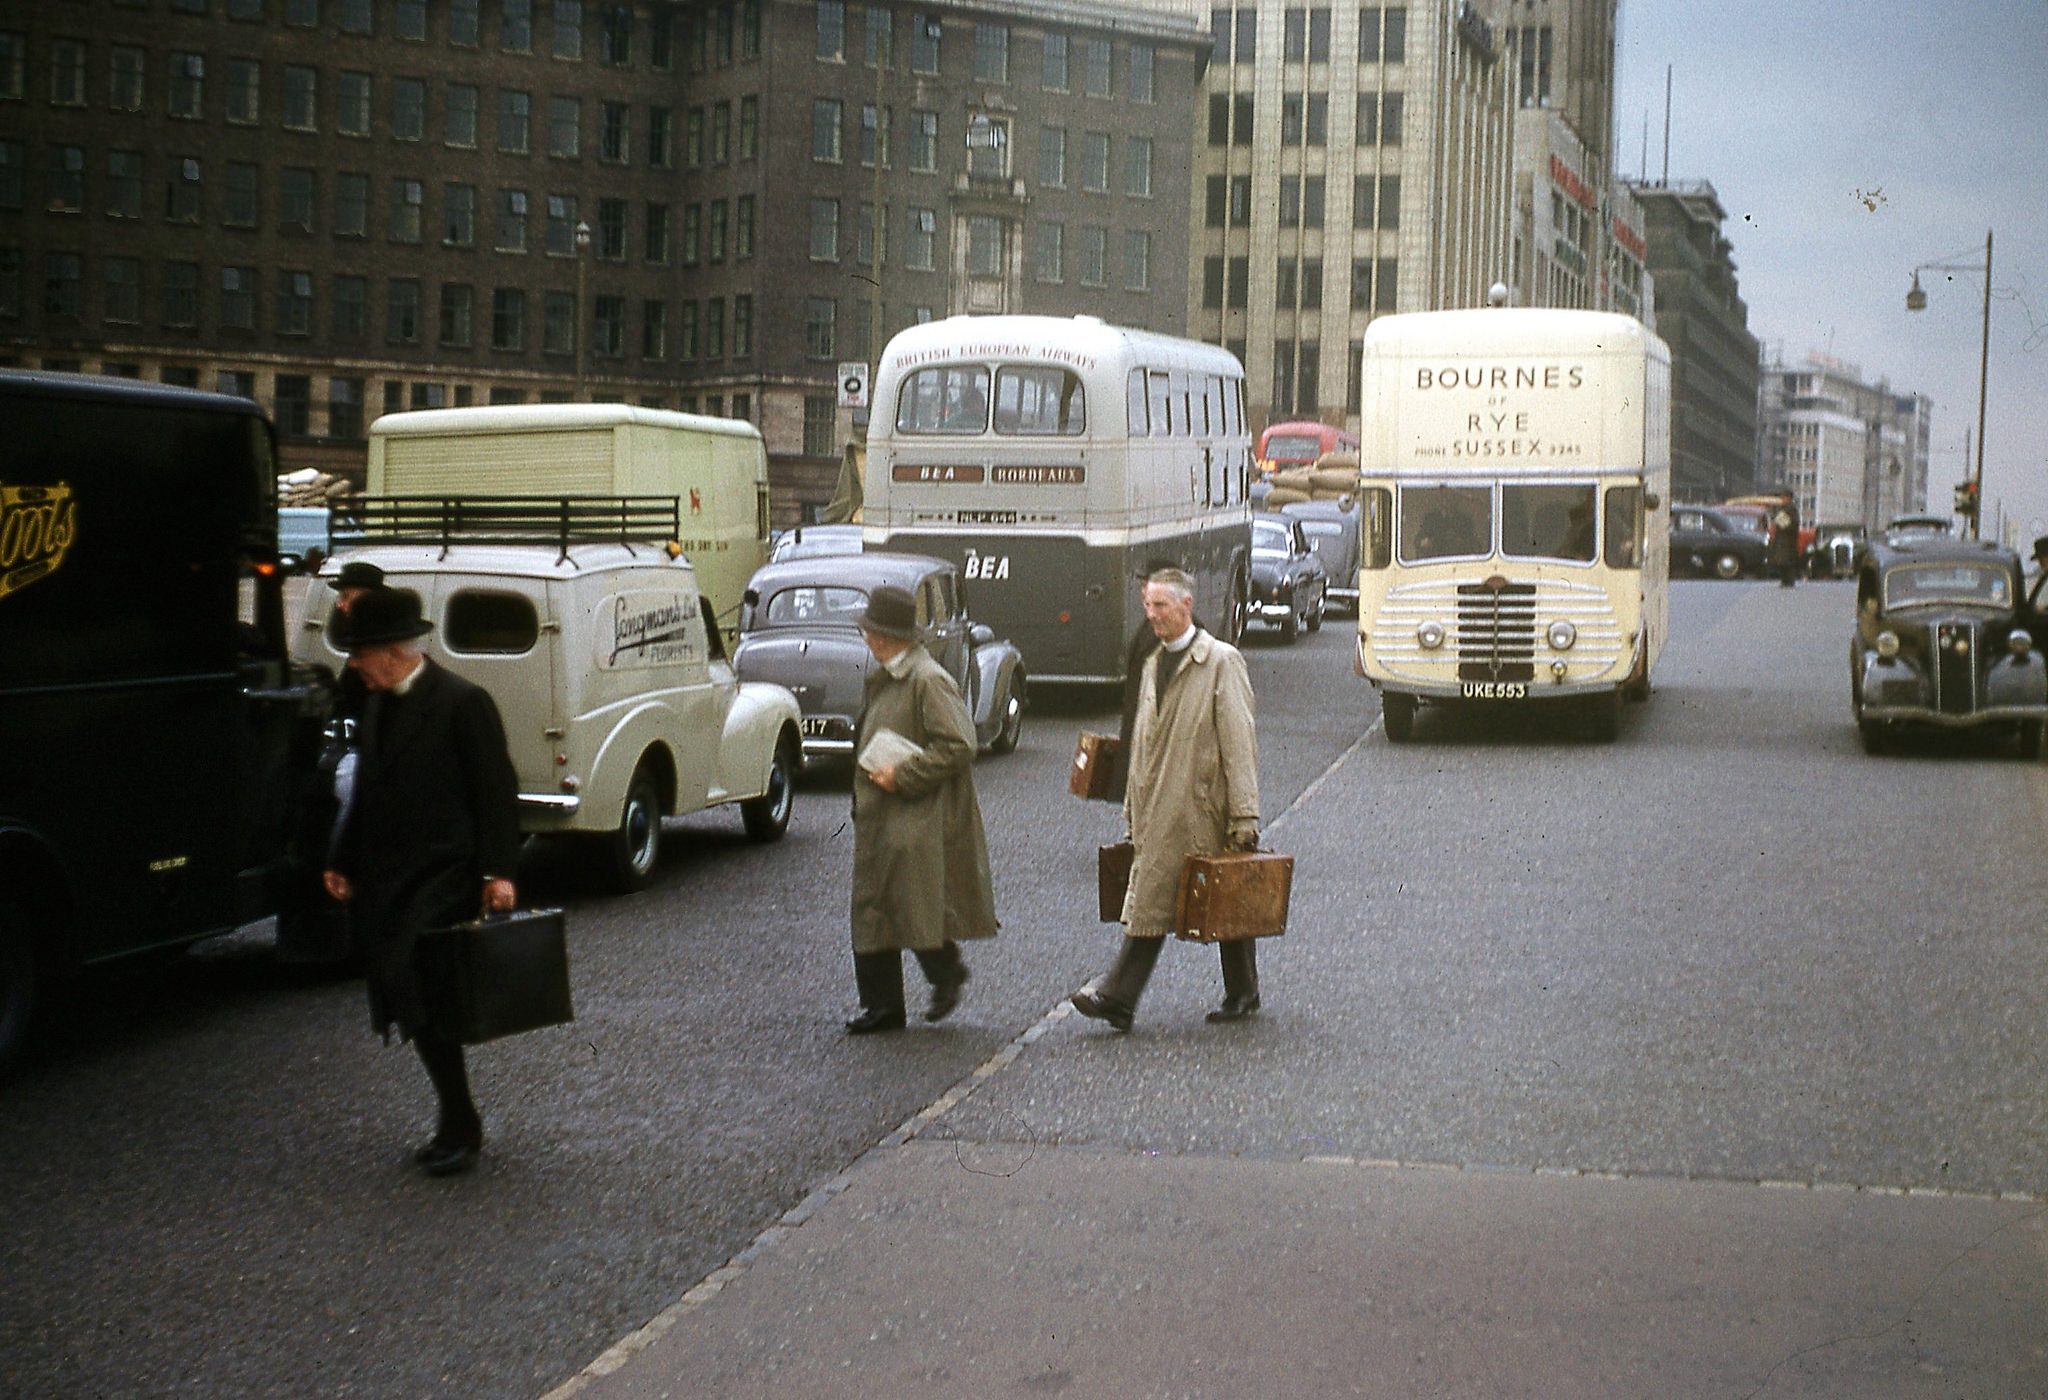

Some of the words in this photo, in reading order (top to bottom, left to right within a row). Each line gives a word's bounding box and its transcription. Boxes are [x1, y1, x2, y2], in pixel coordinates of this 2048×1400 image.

[896, 347, 951, 369] BRITISH
[959, 344, 1031, 357] EUROPEAN
[1040, 345, 1097, 371] AIRWAYS
[1417, 366, 1583, 391] BOURNES
[1468, 412, 1529, 433] RYE
[1415, 446, 1447, 457] PHONE
[1453, 439, 1541, 457] SUSSEX
[920, 465, 955, 481] BEA
[998, 467, 1076, 482] BORDEAUX
[964, 554, 1010, 580] BEA
